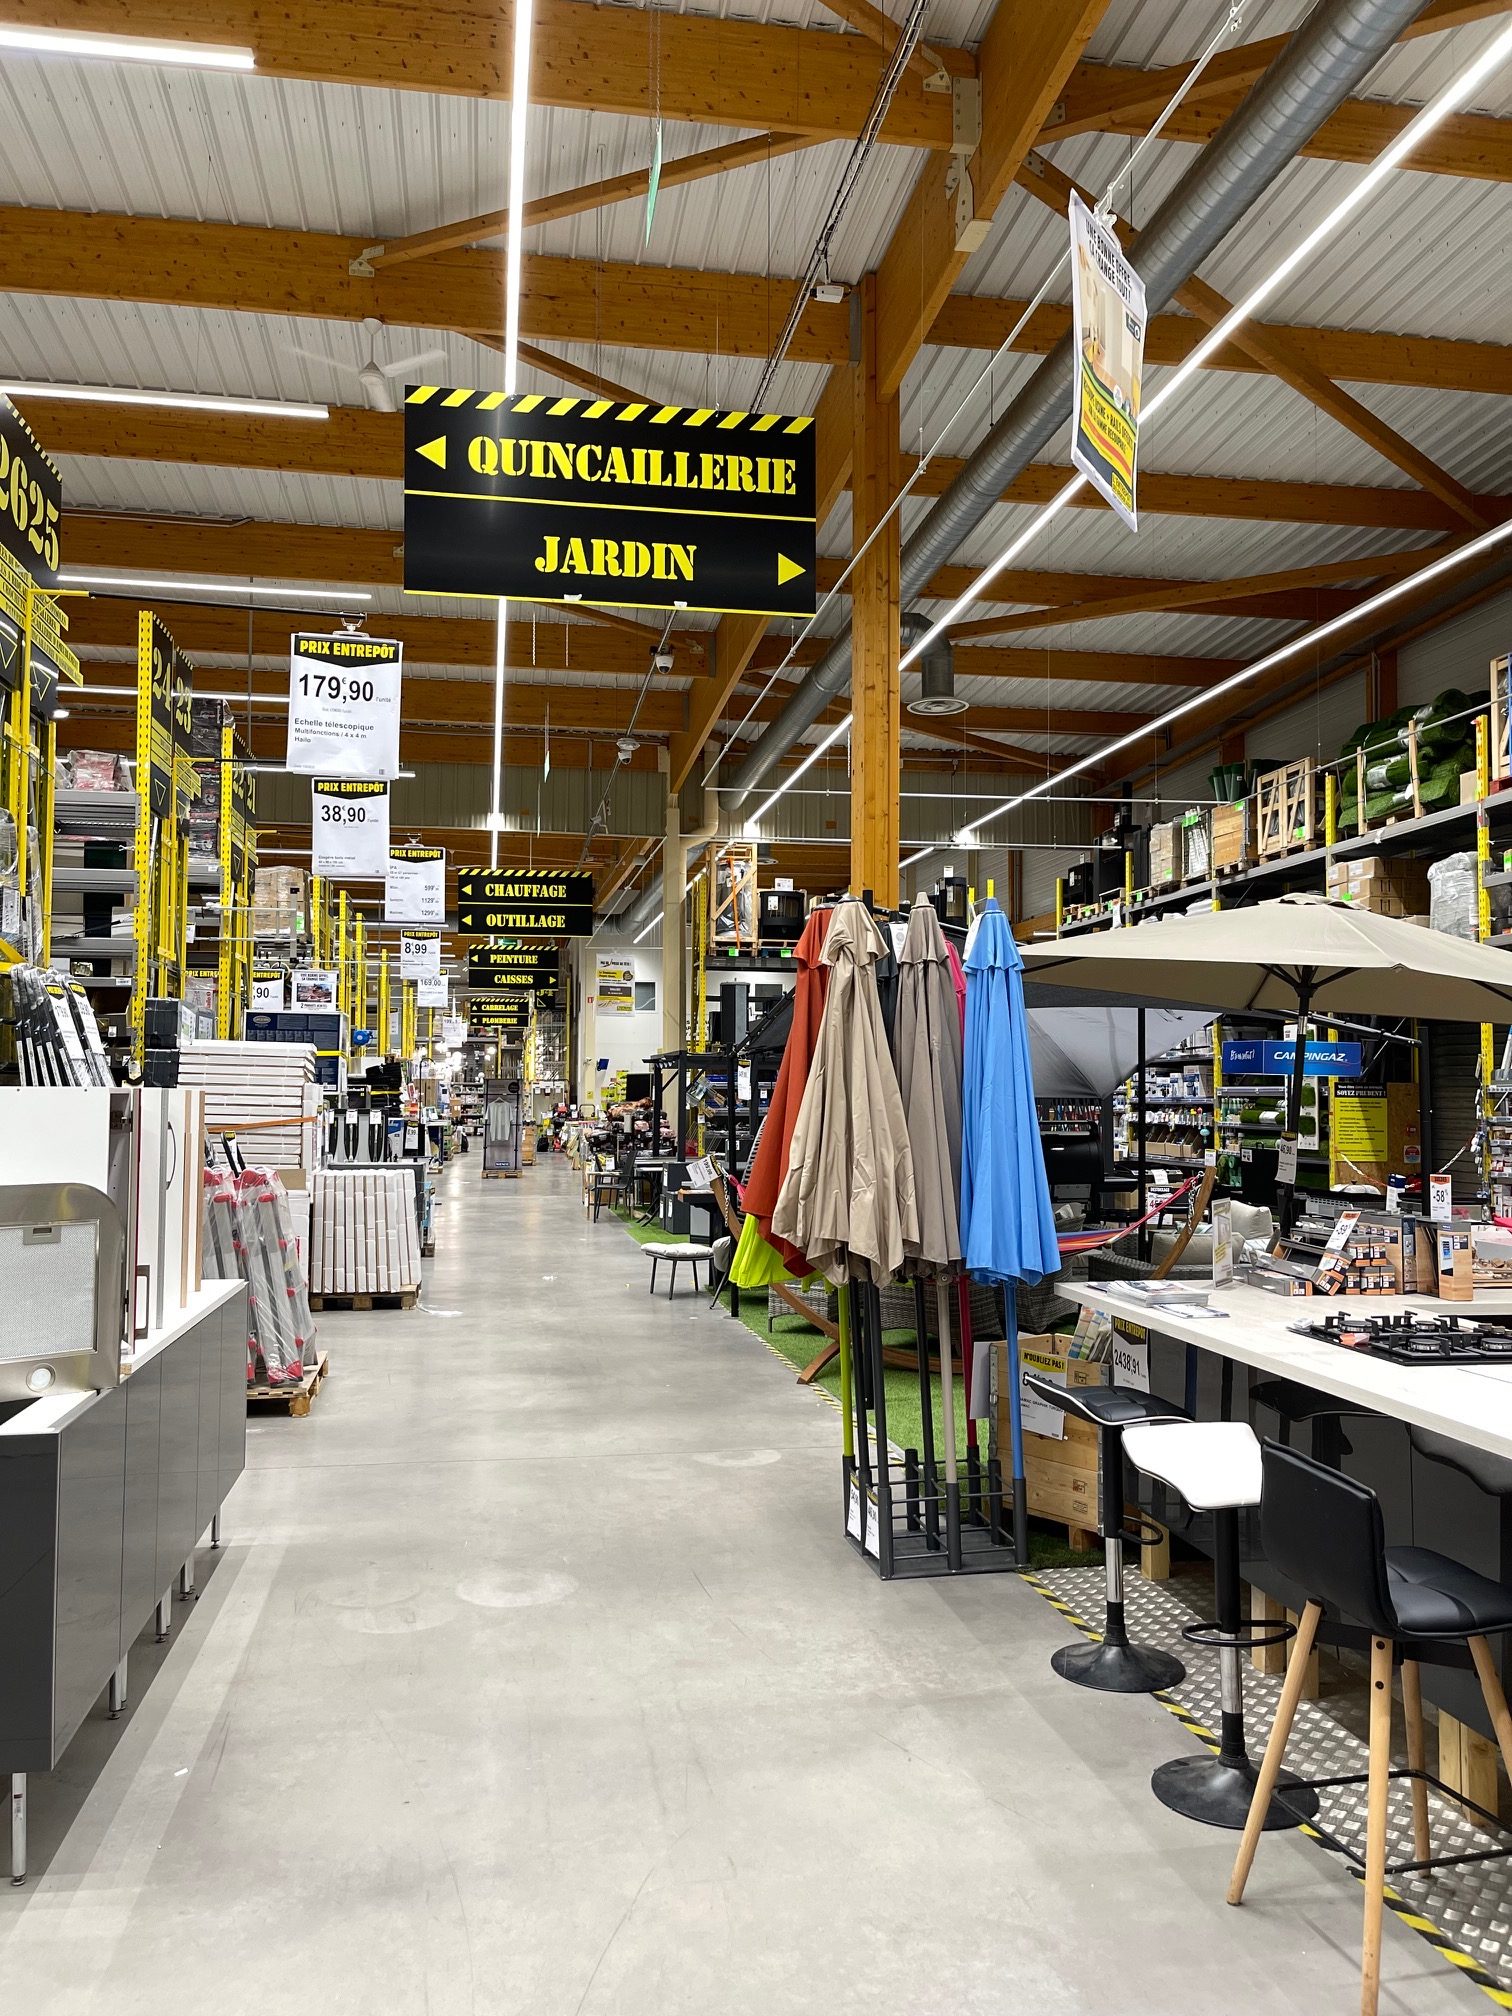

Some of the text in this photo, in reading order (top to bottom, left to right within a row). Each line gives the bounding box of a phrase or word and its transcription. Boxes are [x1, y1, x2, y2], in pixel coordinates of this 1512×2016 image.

[468, 435, 797, 495] QUINCAILLERIE
[534, 535, 697, 581] JARDIN
[300, 640, 396, 659] PRIX ENTREPÔT
[152, 647, 171, 712] 24
[175, 676, 192, 734] 23
[294, 717, 375, 731] Echelle télescopique
[294, 728, 340, 737] Multifonctions
[317, 782, 384, 793] PRIX ENTREPÔT
[407, 849, 442, 858] ENTREPÔT
[484, 883, 567, 898] CHAUFFAGE
[486, 914, 566, 928] OUTILLAGE
[489, 954, 538, 964] PEINTURE
[494, 974, 534, 985] CAISSES
[1113, 1318, 1125, 1332] PRIX
[1023, 1352, 1051, 1366] N'OUBLIEZ
[1051, 1358, 1061, 1369] PAS
